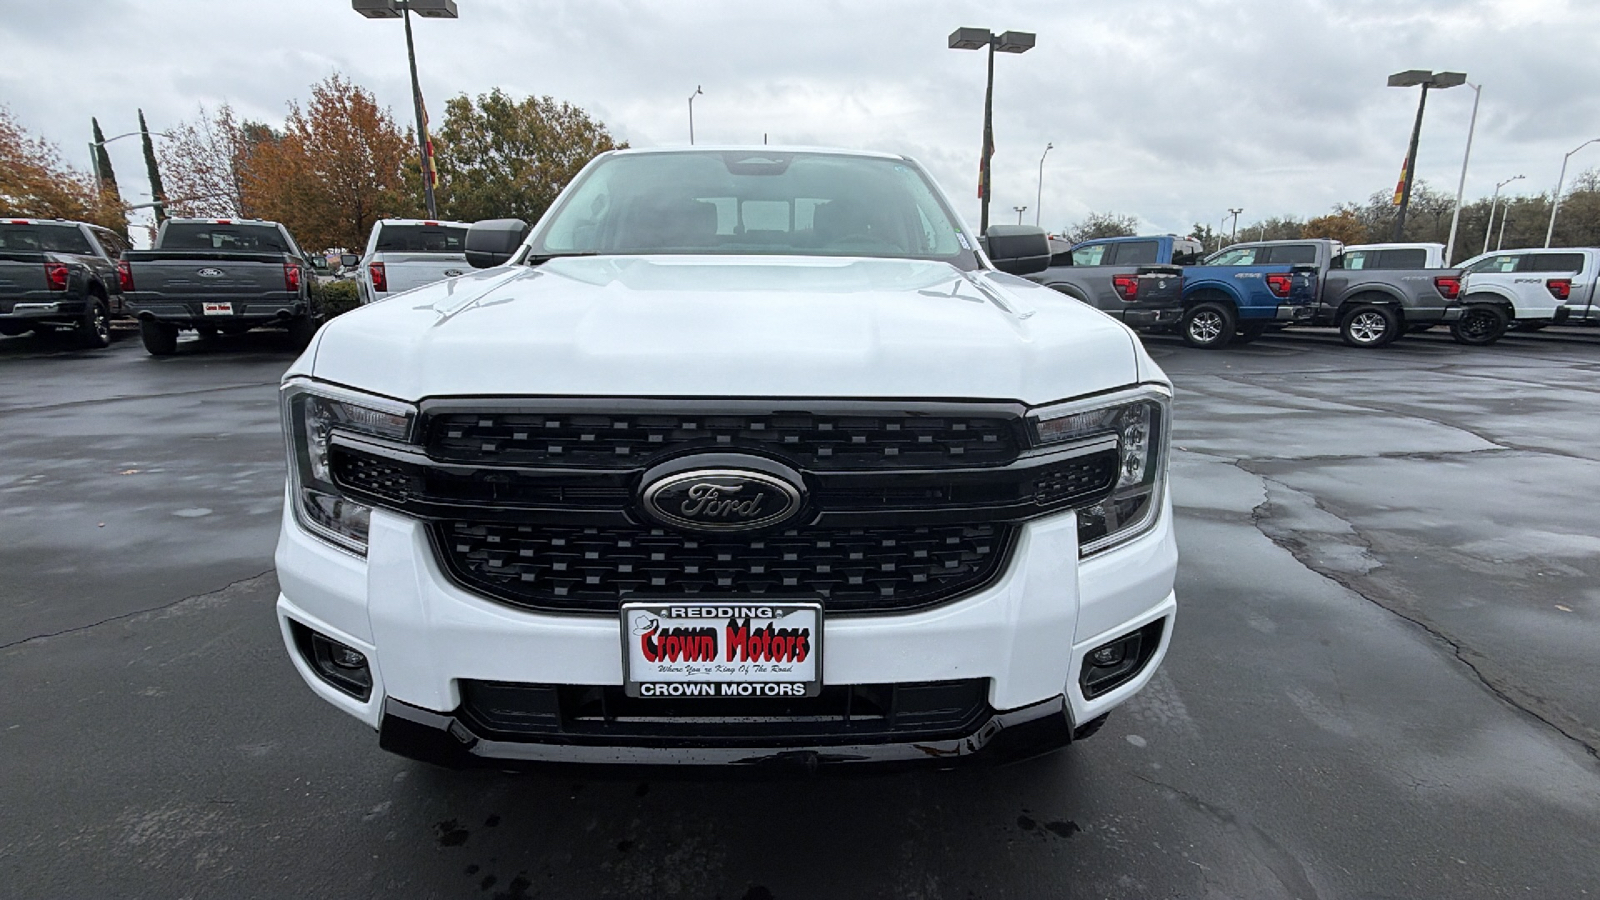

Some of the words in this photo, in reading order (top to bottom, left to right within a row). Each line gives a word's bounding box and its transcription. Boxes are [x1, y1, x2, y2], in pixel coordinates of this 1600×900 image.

[681, 482, 764, 517] Ford
[671, 607, 773, 618] REDDING
[641, 618, 718, 663] Crown
[726, 617, 810, 663] Motors
[657, 664, 683, 673] Where
[715, 664, 735, 675] King
[738, 664, 750, 675] Of
[752, 664, 767, 673] The
[770, 664, 794, 673] Road
[640, 683, 715, 696] CROWN
[721, 683, 806, 696] MOTORS
